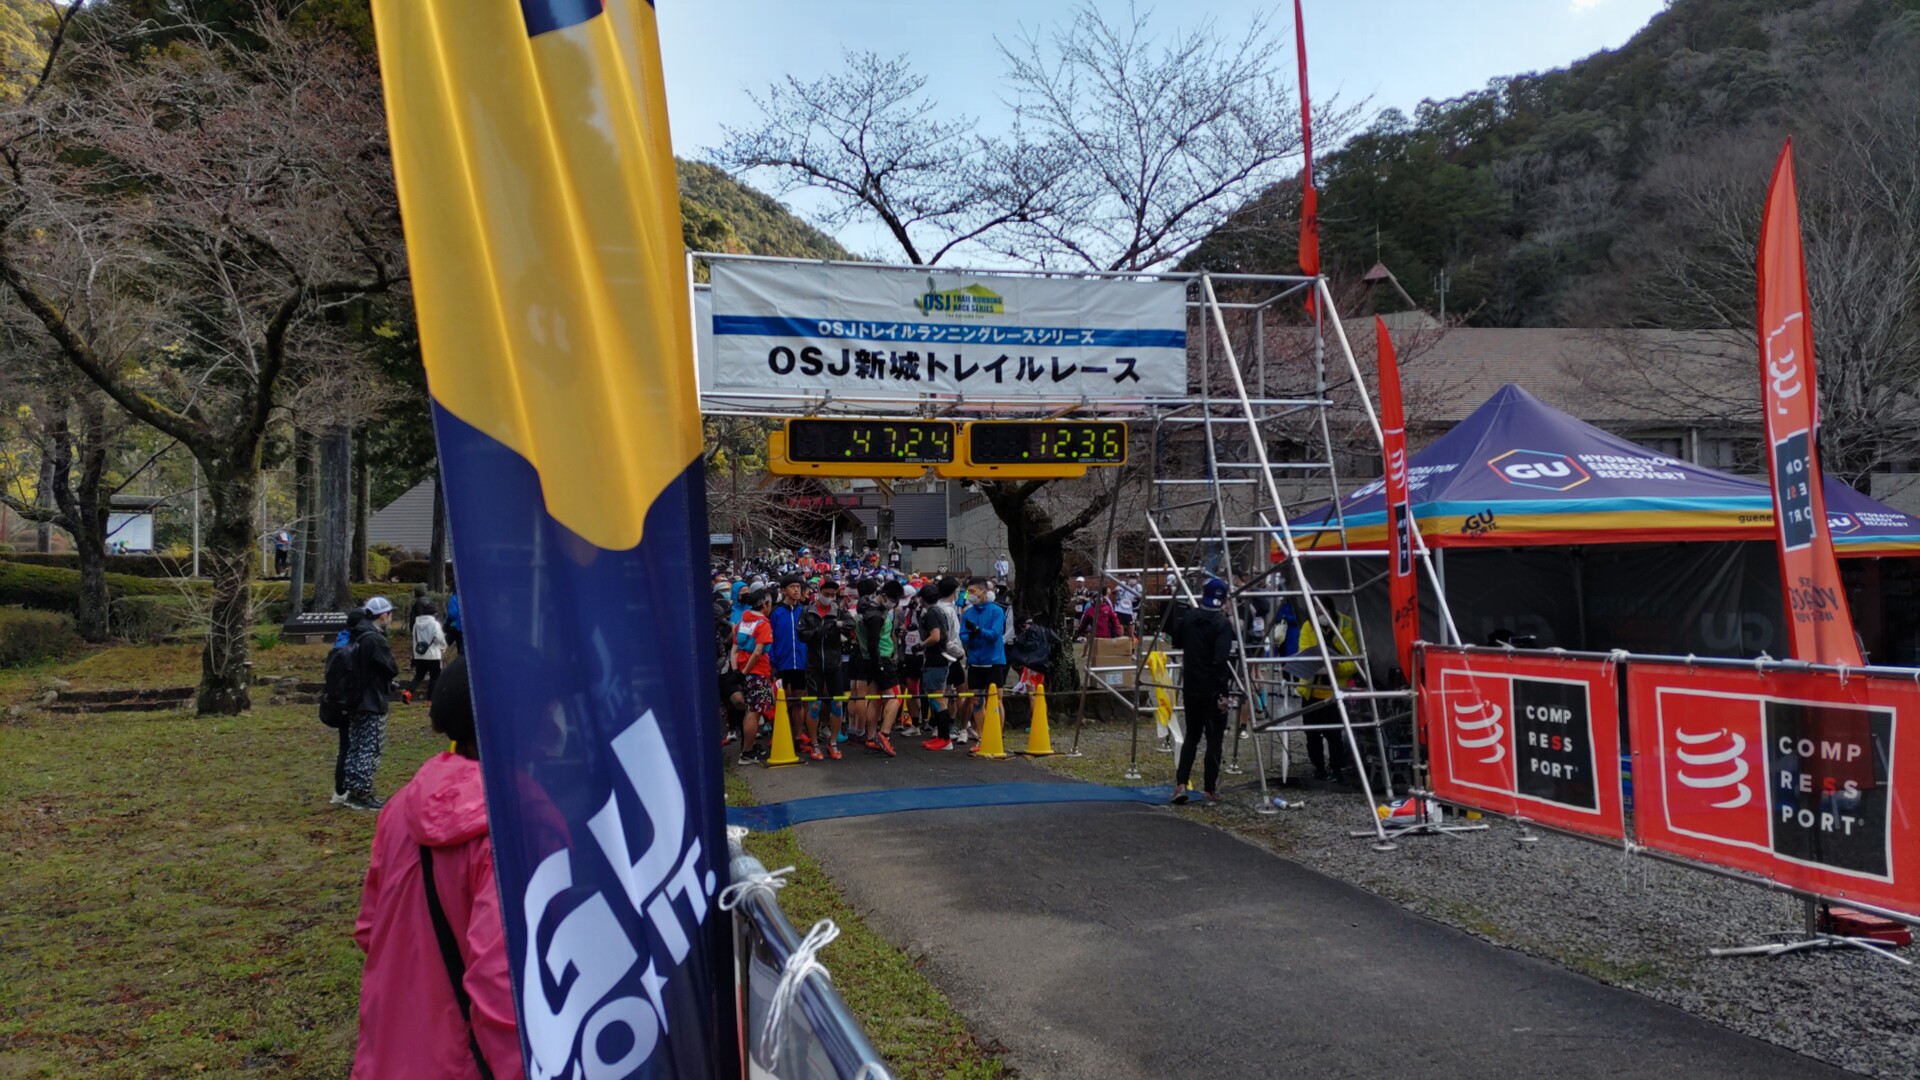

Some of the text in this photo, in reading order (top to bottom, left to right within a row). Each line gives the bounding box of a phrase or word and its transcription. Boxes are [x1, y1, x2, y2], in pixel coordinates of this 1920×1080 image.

[818, 320, 1095, 345] OSJトレイルランニングレースシリーズ
[768, 346, 1141, 384] OSJ新城トレイルレース
[1505, 461, 1572, 479] GU
[1578, 454, 1680, 467] HYDRATION
[1587, 462, 1654, 473] ENERGY
[1596, 470, 1687, 481] RECOVERY
[1738, 513, 1774, 524] guene
[1526, 705, 1572, 724] COMP
[1528, 731, 1573, 753] RESS
[1778, 736, 1862, 762] COMP
[1780, 770, 1858, 799] RESS
